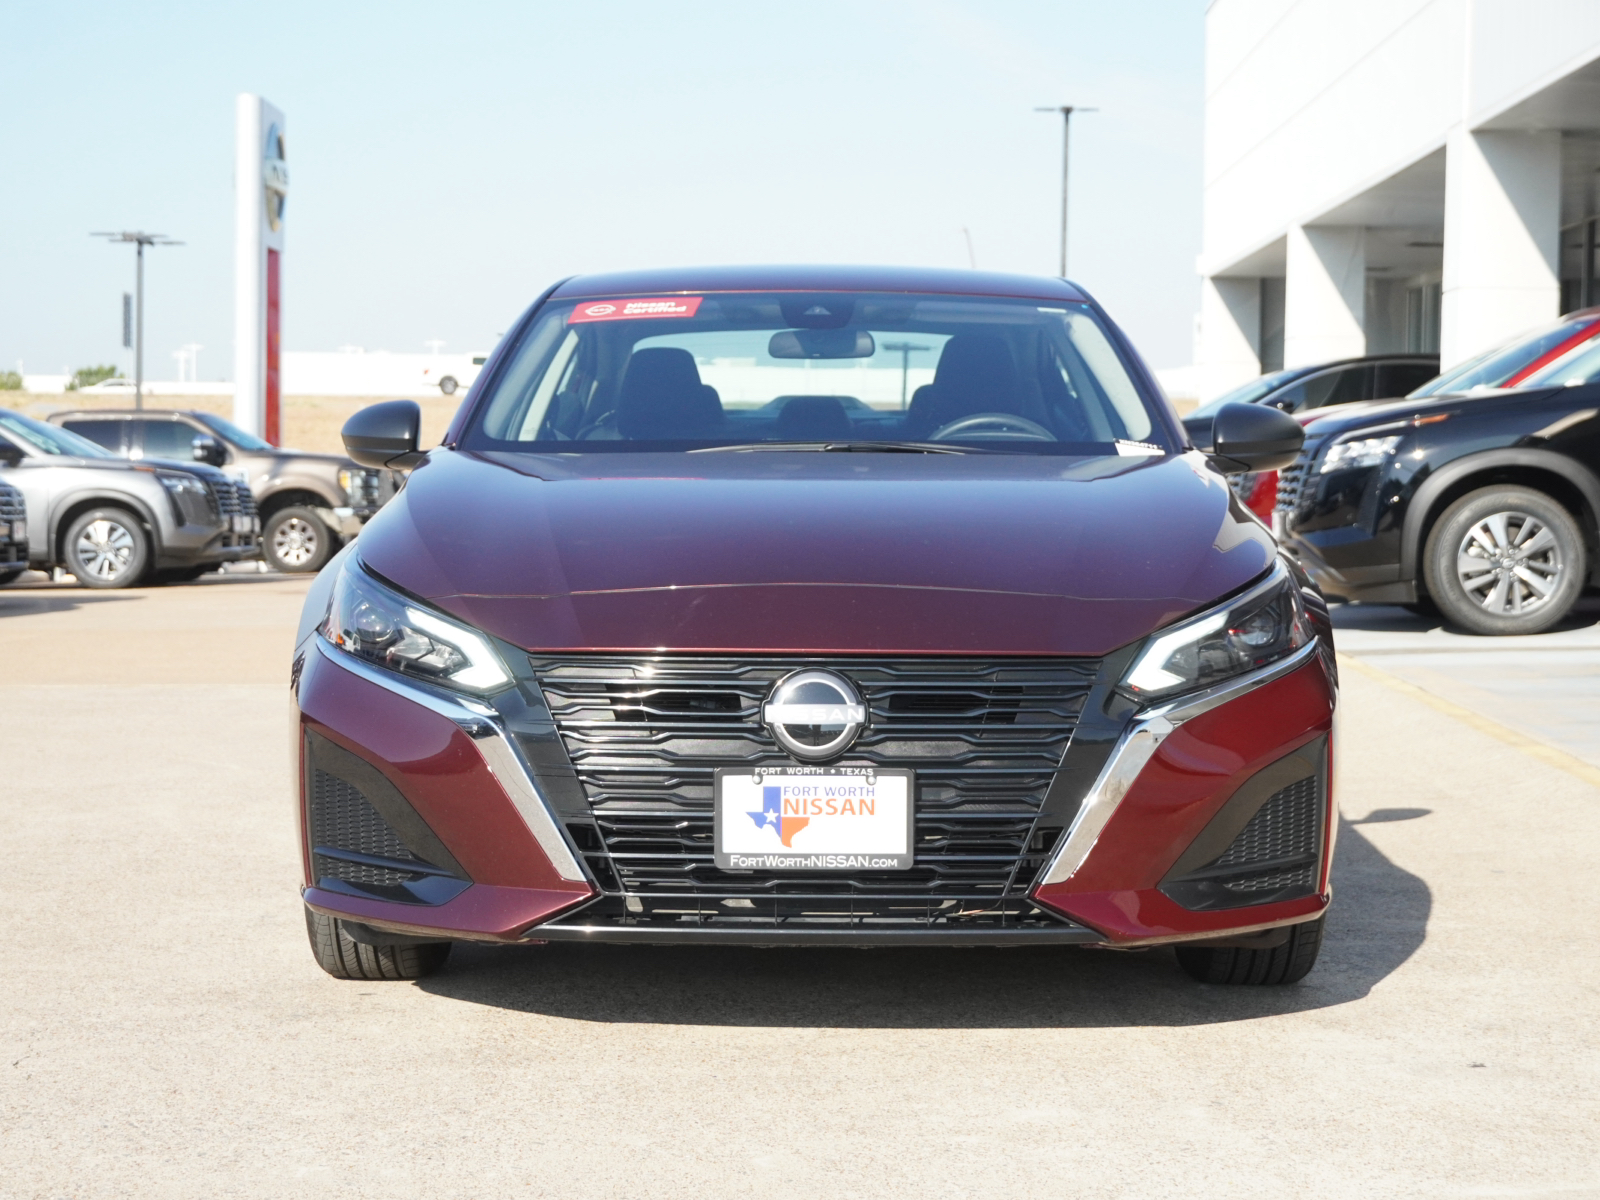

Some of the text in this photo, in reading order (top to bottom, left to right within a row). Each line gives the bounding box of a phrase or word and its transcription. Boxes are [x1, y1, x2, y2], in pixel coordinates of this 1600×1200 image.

[767, 707, 863, 721] NSSAN
[754, 767, 874, 776] FORT WORTH TEXAS
[783, 786, 875, 797] FORT WORTH
[783, 798, 875, 816] NISSAN
